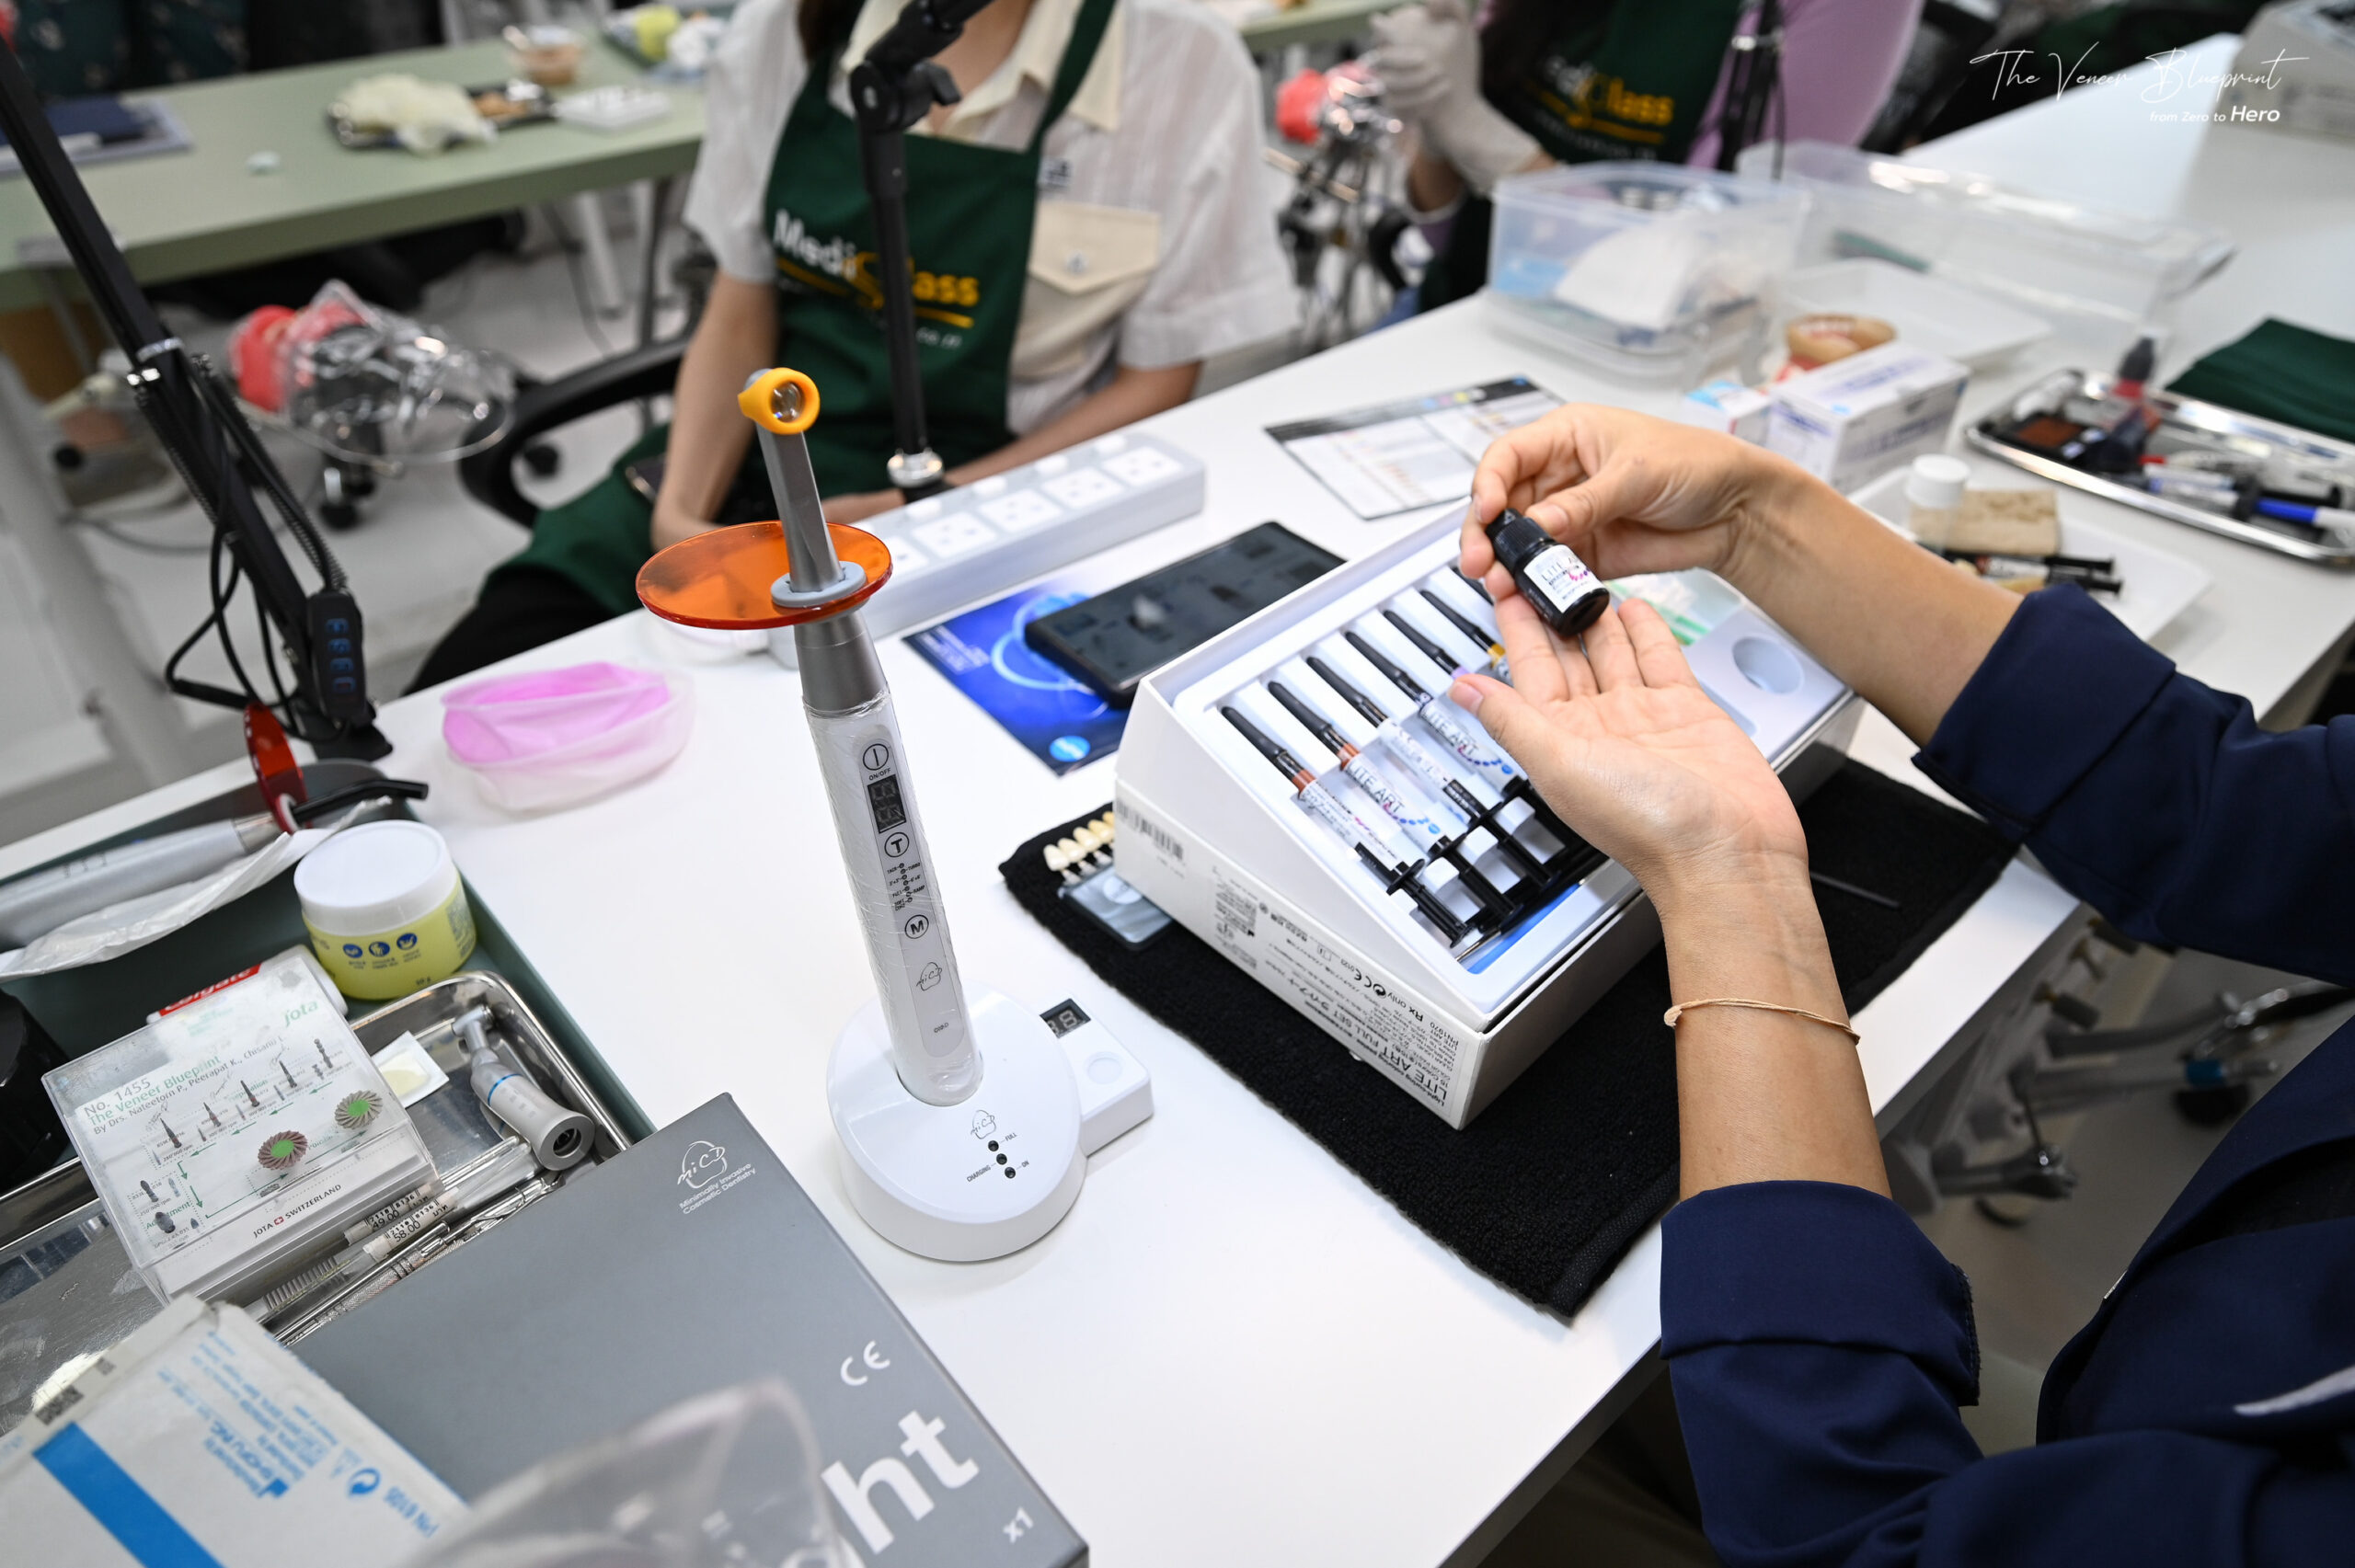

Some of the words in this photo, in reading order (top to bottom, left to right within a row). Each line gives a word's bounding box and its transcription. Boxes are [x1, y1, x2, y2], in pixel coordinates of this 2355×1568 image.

[868, 768, 890, 780] ON/OFF
[1346, 759, 1377, 789] LITE
[1373, 784, 1405, 815] ART
[1385, 990, 1407, 1009] only
[284, 1000, 318, 1027] jota
[1331, 1009, 1353, 1027] SET
[1407, 1006, 1425, 1022] Rx
[1352, 1024, 1378, 1047] FULL
[1430, 1028, 1442, 1039] ART
[1442, 1037, 1457, 1050] LITE
[1380, 1045, 1411, 1069] ART
[88, 1107, 114, 1127] The
[115, 1083, 162, 1114] Veneer
[163, 1053, 222, 1090] Blueprint
[108, 1114, 125, 1127] Drs.
[188, 1061, 228, 1088] Peerapat
[1414, 1069, 1446, 1100] LITE
[83, 1096, 110, 1117] No.
[113, 1076, 151, 1102] 1455
[1005, 1131, 1017, 1141] FULL
[718, 1162, 752, 1184] Invasive
[720, 1167, 756, 1191] Dentistry
[253, 1222, 274, 1238] JOTA
[284, 1184, 341, 1219] SWITZERLAND
[371, 1208, 400, 1230] 49.00
[415, 1204, 433, 1219] 8136
[393, 1219, 421, 1242] 58.00
